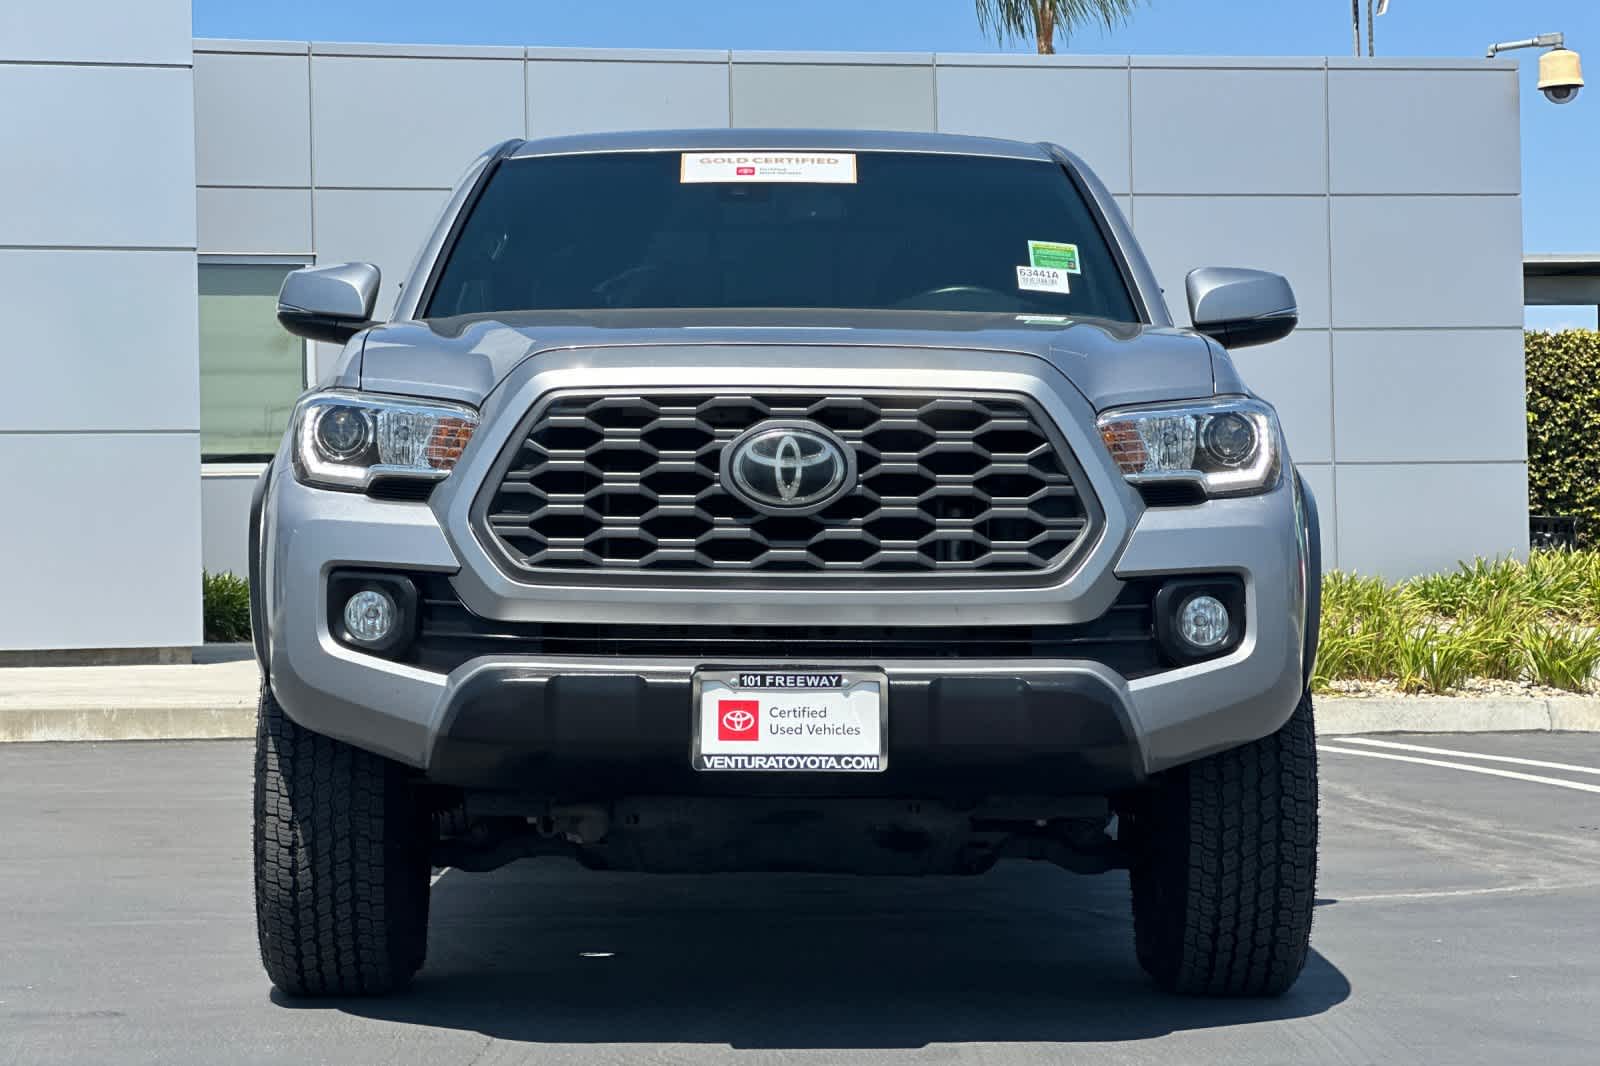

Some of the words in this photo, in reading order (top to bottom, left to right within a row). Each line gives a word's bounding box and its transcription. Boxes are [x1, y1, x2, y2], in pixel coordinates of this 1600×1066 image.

[699, 157, 748, 165] GOLD
[752, 157, 839, 165] CERTIFIED
[741, 675, 761, 686] 101
[766, 675, 839, 687] FREEWAY
[769, 706, 827, 719] Certified
[769, 723, 803, 736] Used
[807, 723, 861, 736] Vehicles
[703, 755, 878, 770] VENTURATOYOTA.COM
